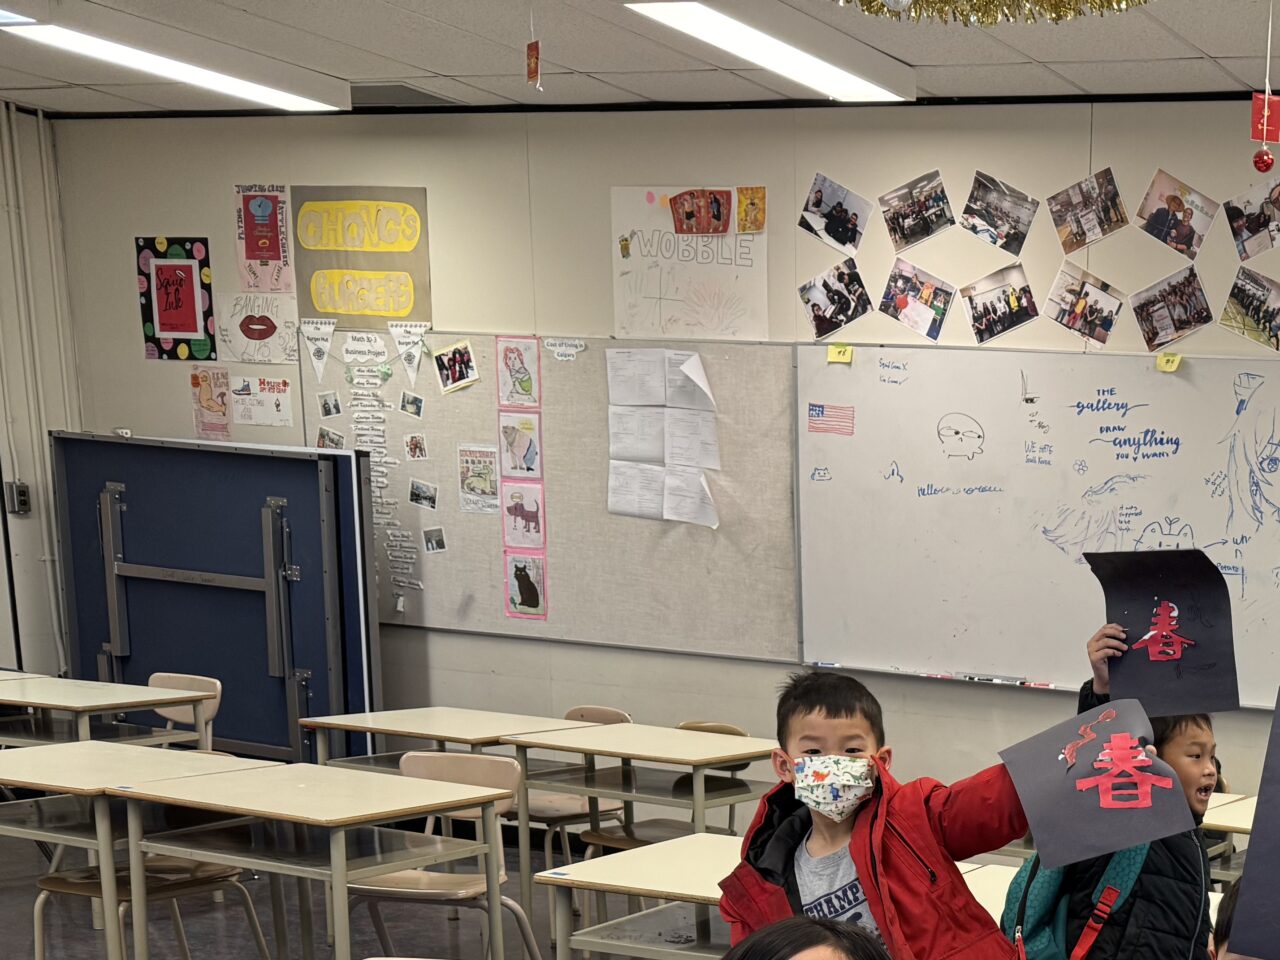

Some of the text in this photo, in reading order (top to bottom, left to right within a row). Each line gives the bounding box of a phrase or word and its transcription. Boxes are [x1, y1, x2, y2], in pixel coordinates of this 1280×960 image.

[636, 229, 755, 267] WOBBLE
[162, 289, 184, 312] Ink
[230, 294, 279, 318] BANGING
[367, 349, 386, 357] Project
[1096, 387, 1117, 396] THE
[1070, 398, 1140, 418] gallery
[1099, 425, 1126, 434] DRAW
[1104, 429, 1181, 455] anything
[1116, 452, 1129, 460] YOU
[1075, 733, 1173, 809] 春
